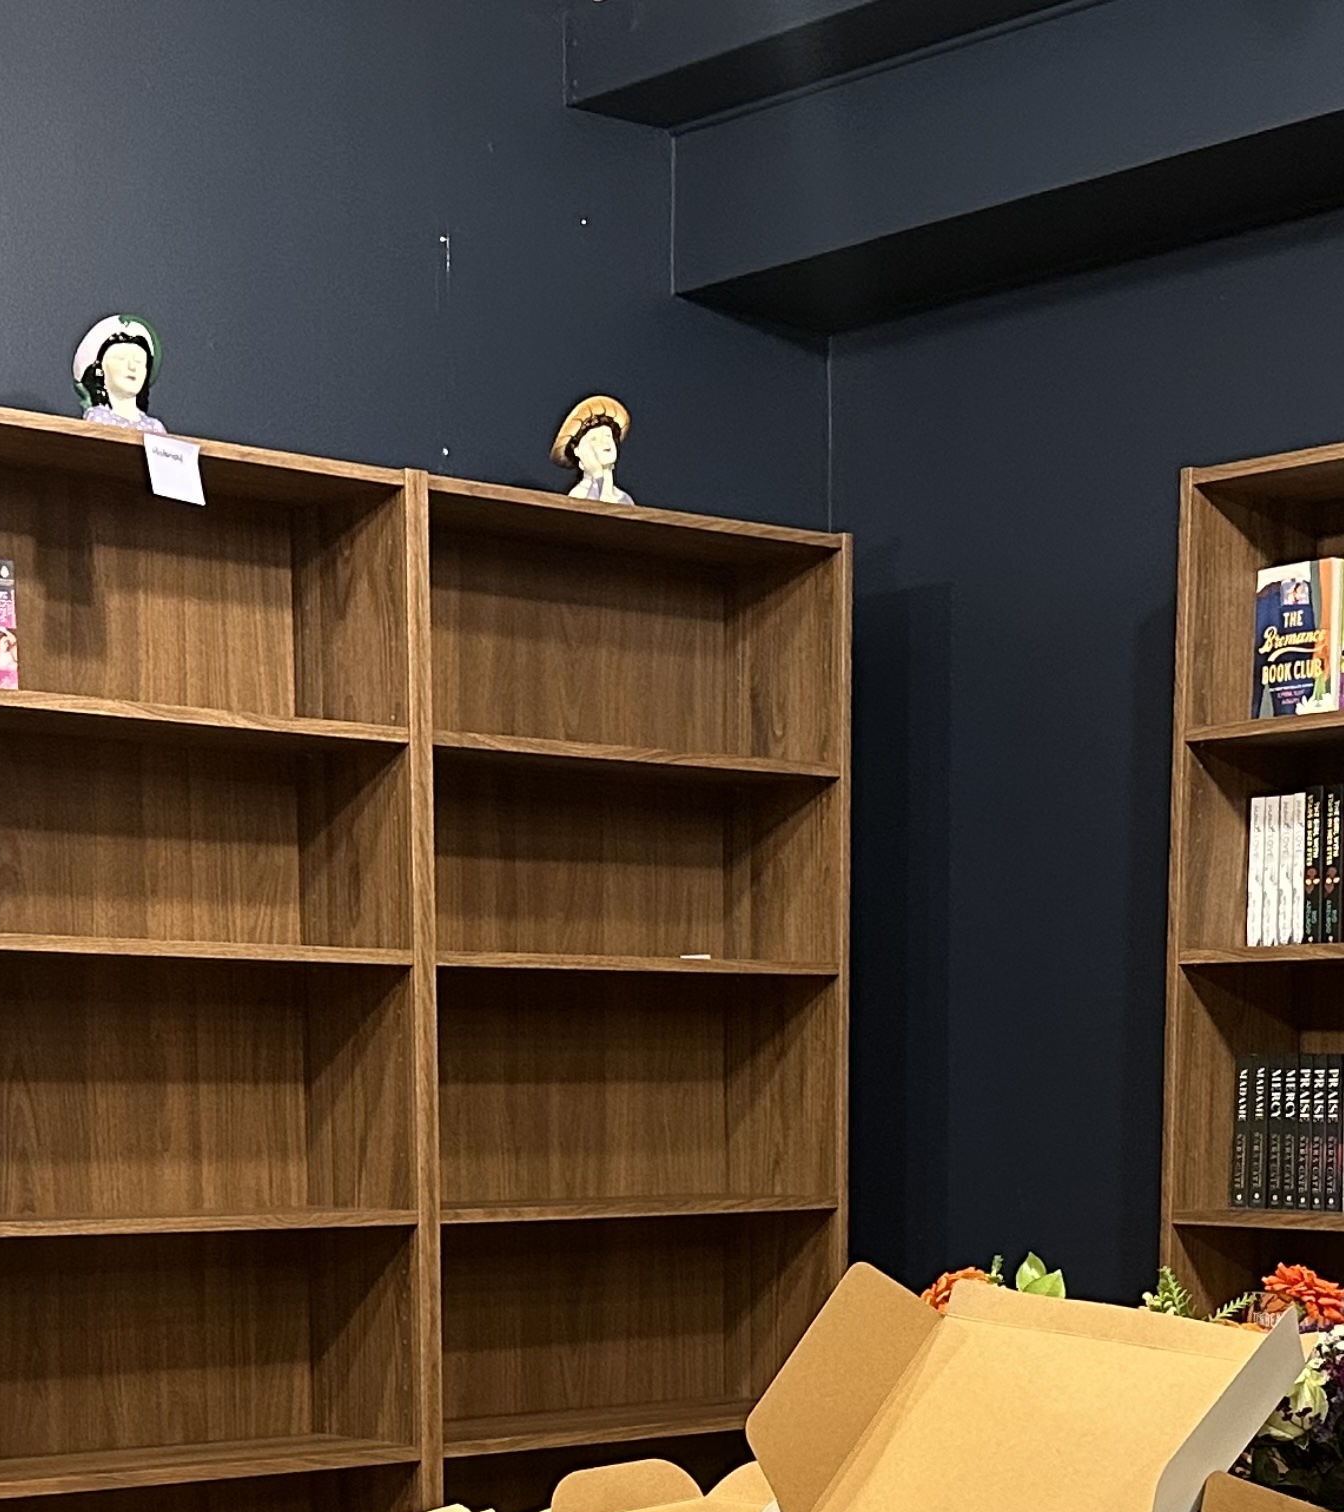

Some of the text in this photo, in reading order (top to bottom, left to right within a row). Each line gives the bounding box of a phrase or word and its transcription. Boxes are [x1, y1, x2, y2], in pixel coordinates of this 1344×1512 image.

[1258, 627, 1328, 654] Bromance
[1283, 610, 1303, 629] THE
[1262, 658, 1323, 684] BOOK CLUB
[1270, 1069, 1282, 1119] MERCY
[1284, 1069, 1296, 1119] MERCY
[1313, 1068, 1325, 1123] PRAISE
[1327, 1068, 1339, 1123] PRAISE
